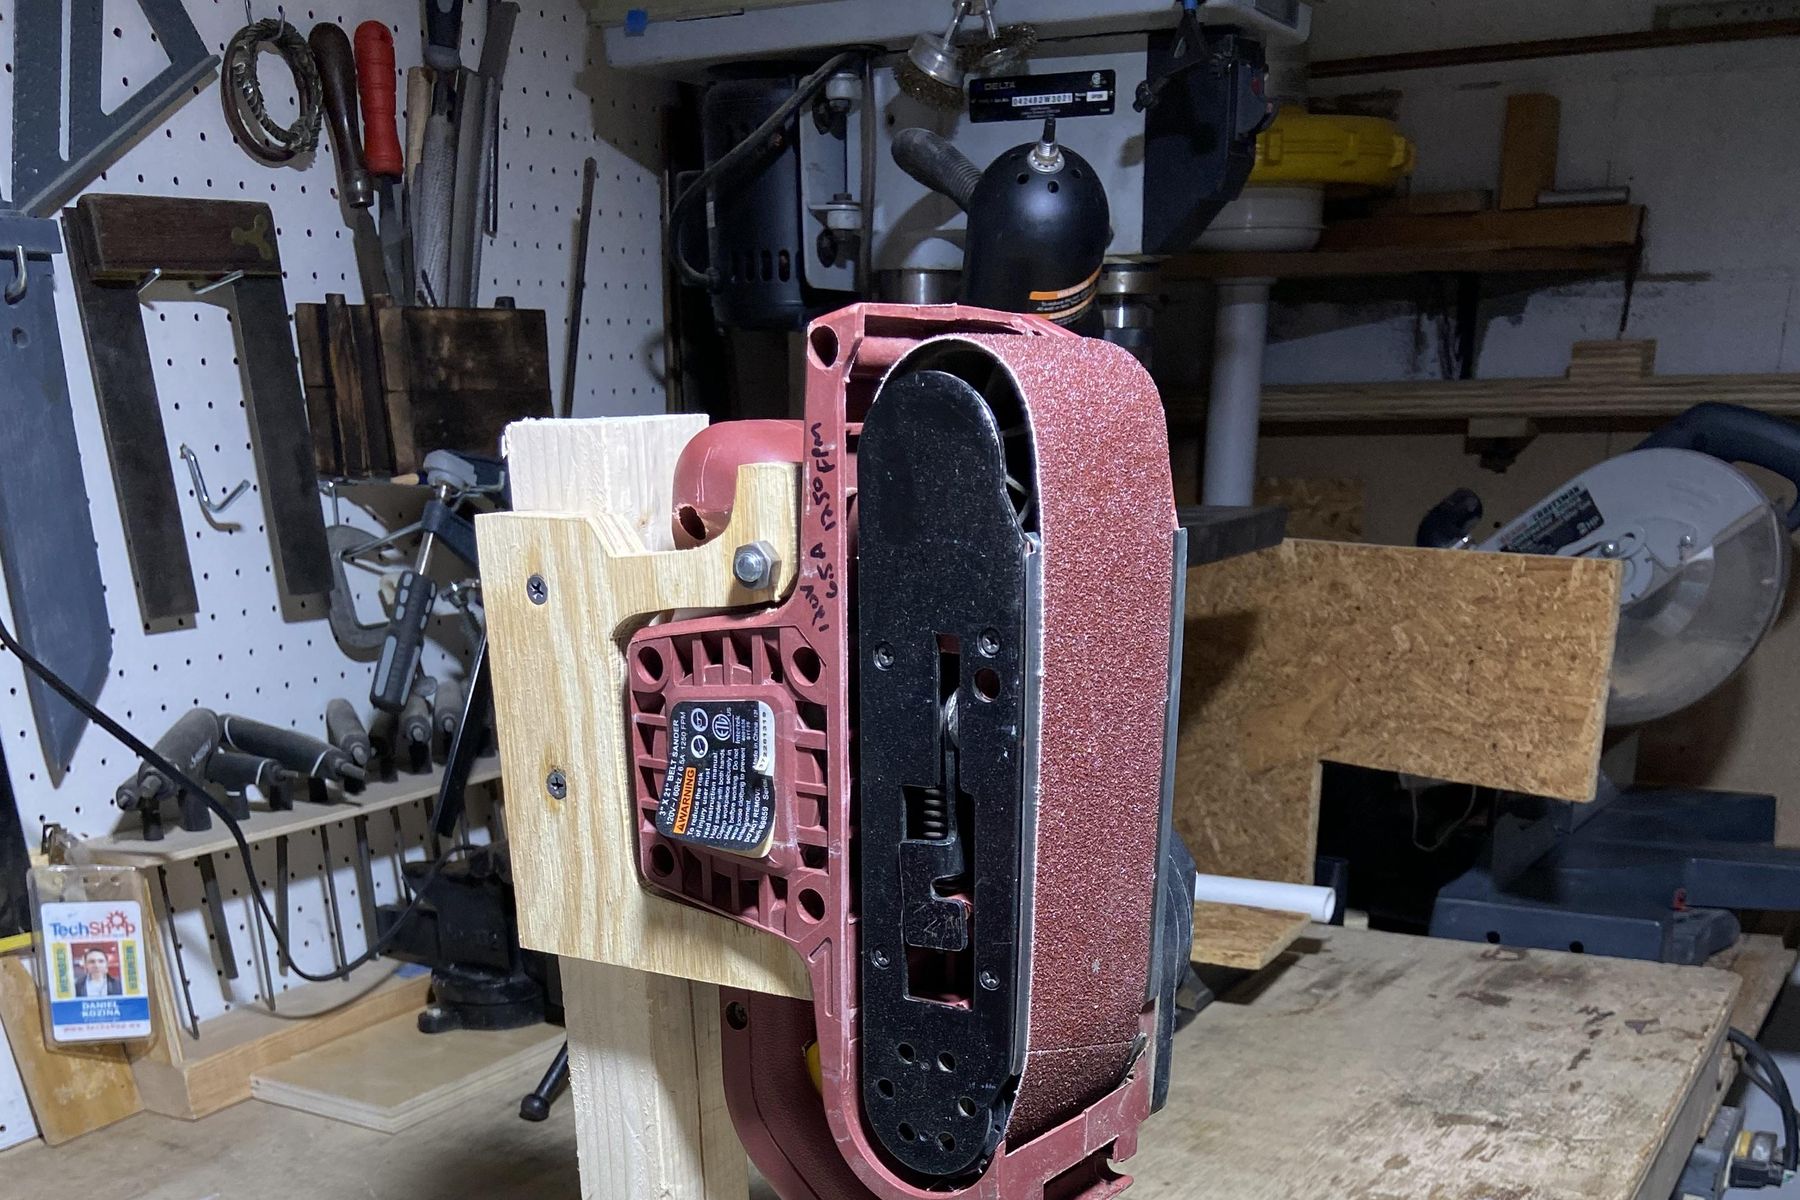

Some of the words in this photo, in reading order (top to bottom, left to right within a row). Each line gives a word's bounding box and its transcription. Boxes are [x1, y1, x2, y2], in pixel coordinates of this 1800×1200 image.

[984, 81, 1016, 91] DELTA
[812, 476, 837, 532] 1250
[667, 759, 677, 781] BELT
[673, 777, 682, 796] 60Hz
[678, 769, 694, 823] WARNING
[716, 820, 727, 839] Clamp
[725, 757, 733, 784] securely
[728, 802, 736, 823] before
[733, 761, 738, 770] Do
[738, 782, 746, 807] clothing
[706, 782, 716, 821] instruction
[686, 827, 694, 835] To
[691, 801, 699, 826] reduce
[703, 822, 711, 838] read
[744, 832, 752, 842] DO
[749, 819, 758, 833] NOT
[696, 829, 701, 837] of
[709, 825, 719, 839] Hold
[50, 911, 136, 938] TechShop
